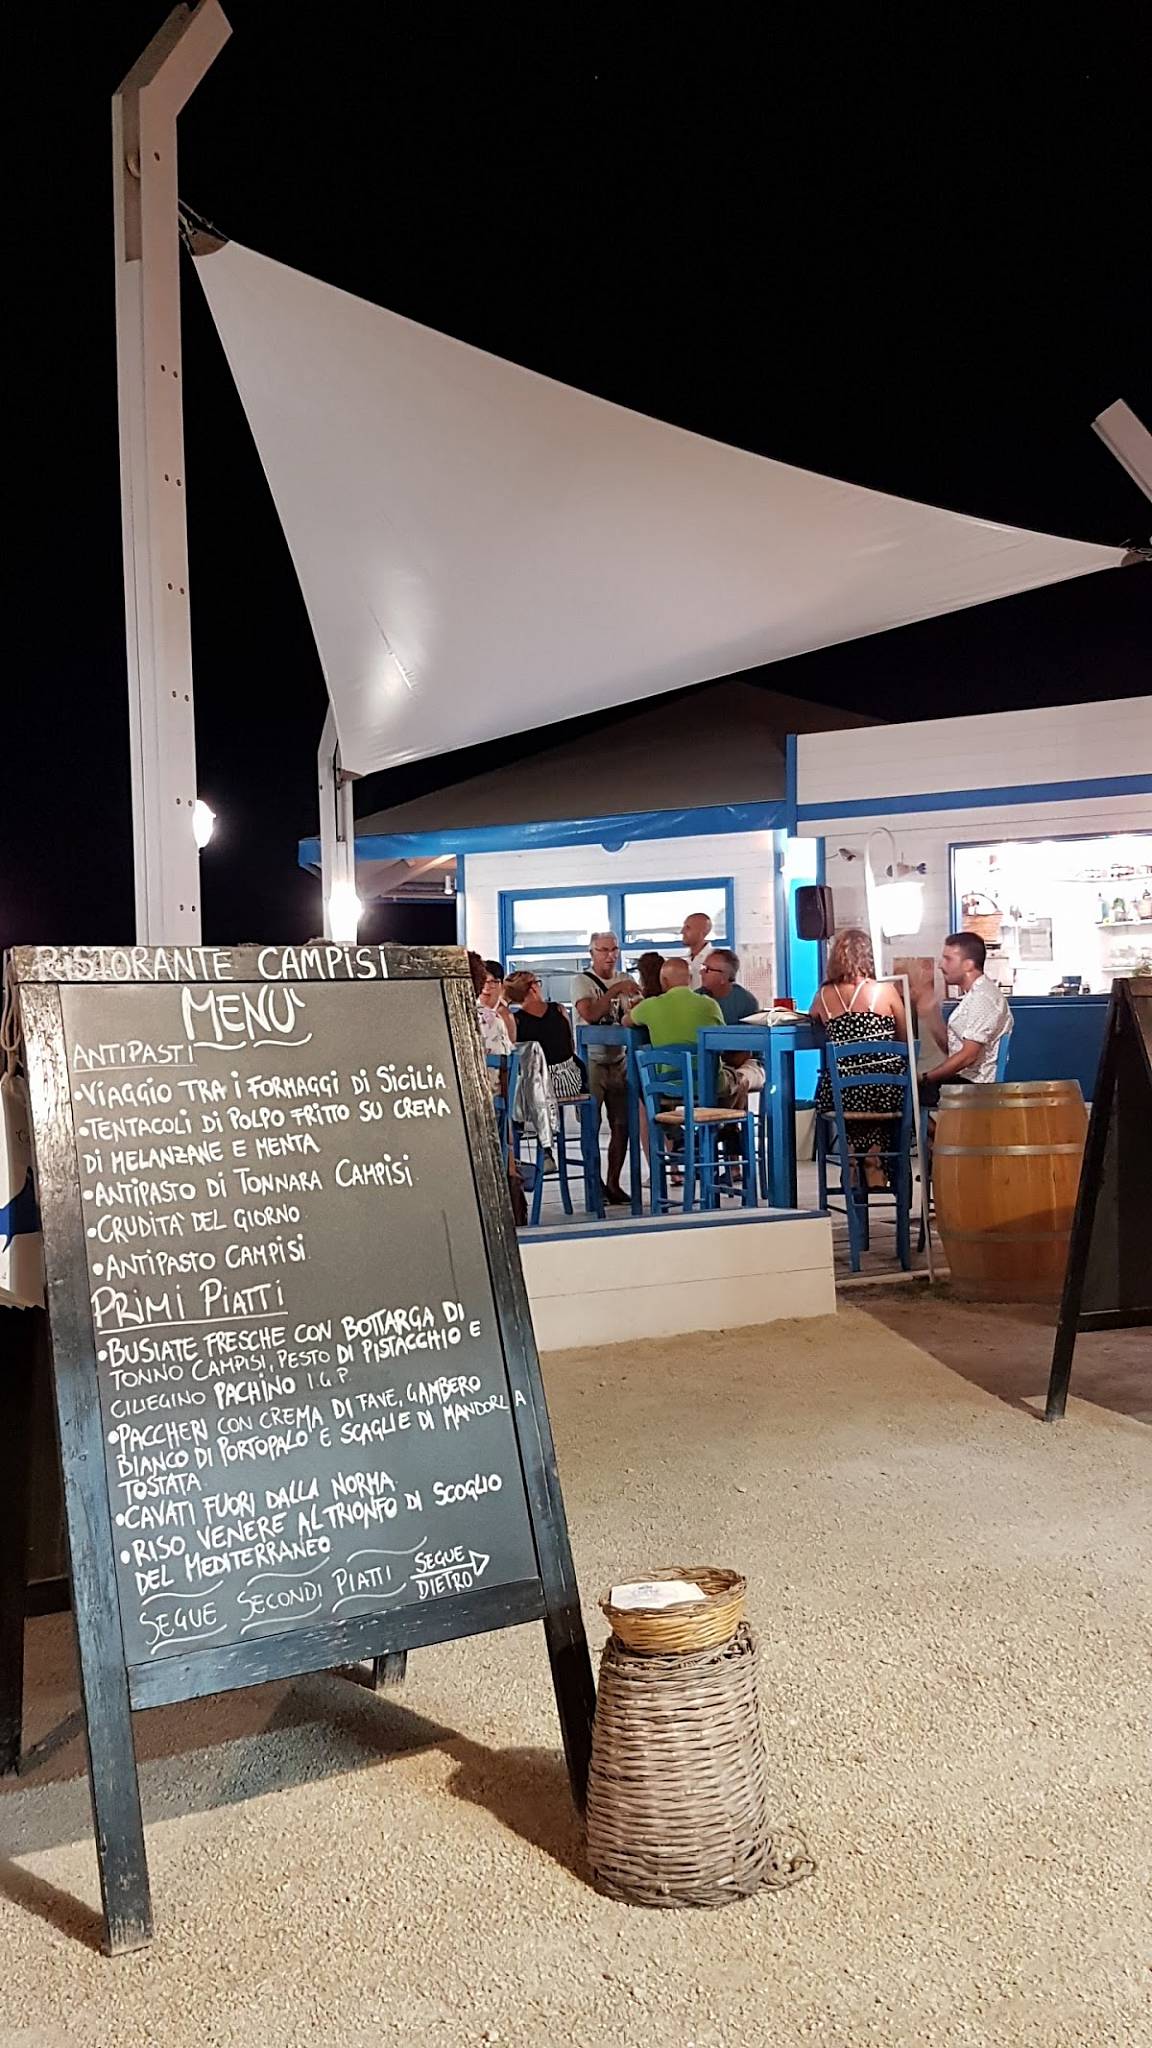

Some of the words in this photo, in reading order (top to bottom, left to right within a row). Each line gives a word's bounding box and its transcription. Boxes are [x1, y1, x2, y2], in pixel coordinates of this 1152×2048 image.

[258, 945, 389, 980] CAMPISI
[73, 1040, 194, 1068] ANTIPASTI
[80, 1077, 172, 1109] VIAGGIO
[177, 1079, 227, 1103] TRA
[246, 1070, 339, 1099] FORMAGGI
[351, 1069, 370, 1095] DI
[376, 1064, 446, 1093] SICILIA
[85, 1109, 192, 1142] TENTACOLI
[202, 1110, 223, 1133] DI
[227, 1106, 285, 1130] POLPO
[290, 1103, 350, 1126] FRITTO
[359, 1100, 383, 1122] SU
[393, 1096, 451, 1119] CREMA
[83, 1149, 103, 1174] DI
[111, 1141, 223, 1175] MELANZANE
[232, 1139, 247, 1158] E
[255, 1133, 321, 1160] MENTA
[95, 1177, 196, 1207] ANTIPASTO
[207, 1171, 227, 1198] DI
[233, 1167, 323, 1196] TONNARA
[191, 1208, 227, 1232] DEL
[106, 1249, 216, 1282] ANTIPASTO
[90, 1284, 185, 1328] PRIMI
[199, 1278, 284, 1317] PIATTI
[106, 1336, 198, 1368] BUSIATE
[203, 1326, 286, 1358] FRESCHE
[294, 1319, 333, 1343] CON
[341, 1306, 435, 1341] BOTTARGA
[442, 1301, 465, 1323] DI
[109, 1363, 184, 1391] TONNO
[277, 1349, 331, 1369] PESTO
[336, 1343, 354, 1365] DI
[361, 1327, 462, 1363] PISTACCHIO
[469, 1320, 481, 1338] E
[110, 1389, 206, 1419] CILIEGINO
[213, 1372, 296, 1410] PACHINO
[116, 1417, 209, 1456] PACCHERI
[217, 1415, 253, 1435] CON
[259, 1404, 324, 1433] CREMA
[331, 1397, 354, 1419] DI
[406, 1375, 481, 1405] GAMBERO
[116, 1451, 188, 1479] BIANCO
[194, 1447, 214, 1470] DI
[217, 1430, 309, 1468] PORTOPALO
[319, 1427, 332, 1448] E
[340, 1411, 411, 1446] SCAGLIE
[416, 1410, 435, 1431] DI
[124, 1500, 197, 1530] CAVATI
[202, 1490, 255, 1524] FUORI
[265, 1477, 319, 1510] DALLA
[131, 1535, 186, 1567] RISO
[196, 1512, 288, 1550] VENERE
[298, 1503, 324, 1538] AL
[322, 1494, 398, 1529] TRIONFO
[404, 1490, 423, 1512] DI
[432, 1473, 503, 1506] SCOGLIO
[134, 1564, 175, 1597] DEL
[414, 1545, 466, 1573] SEGUE
[139, 1601, 217, 1645] SEGUE
[236, 1581, 323, 1622] SECONDI
[331, 1565, 392, 1596] PIATTI
[415, 1570, 474, 1600] DIETRO
